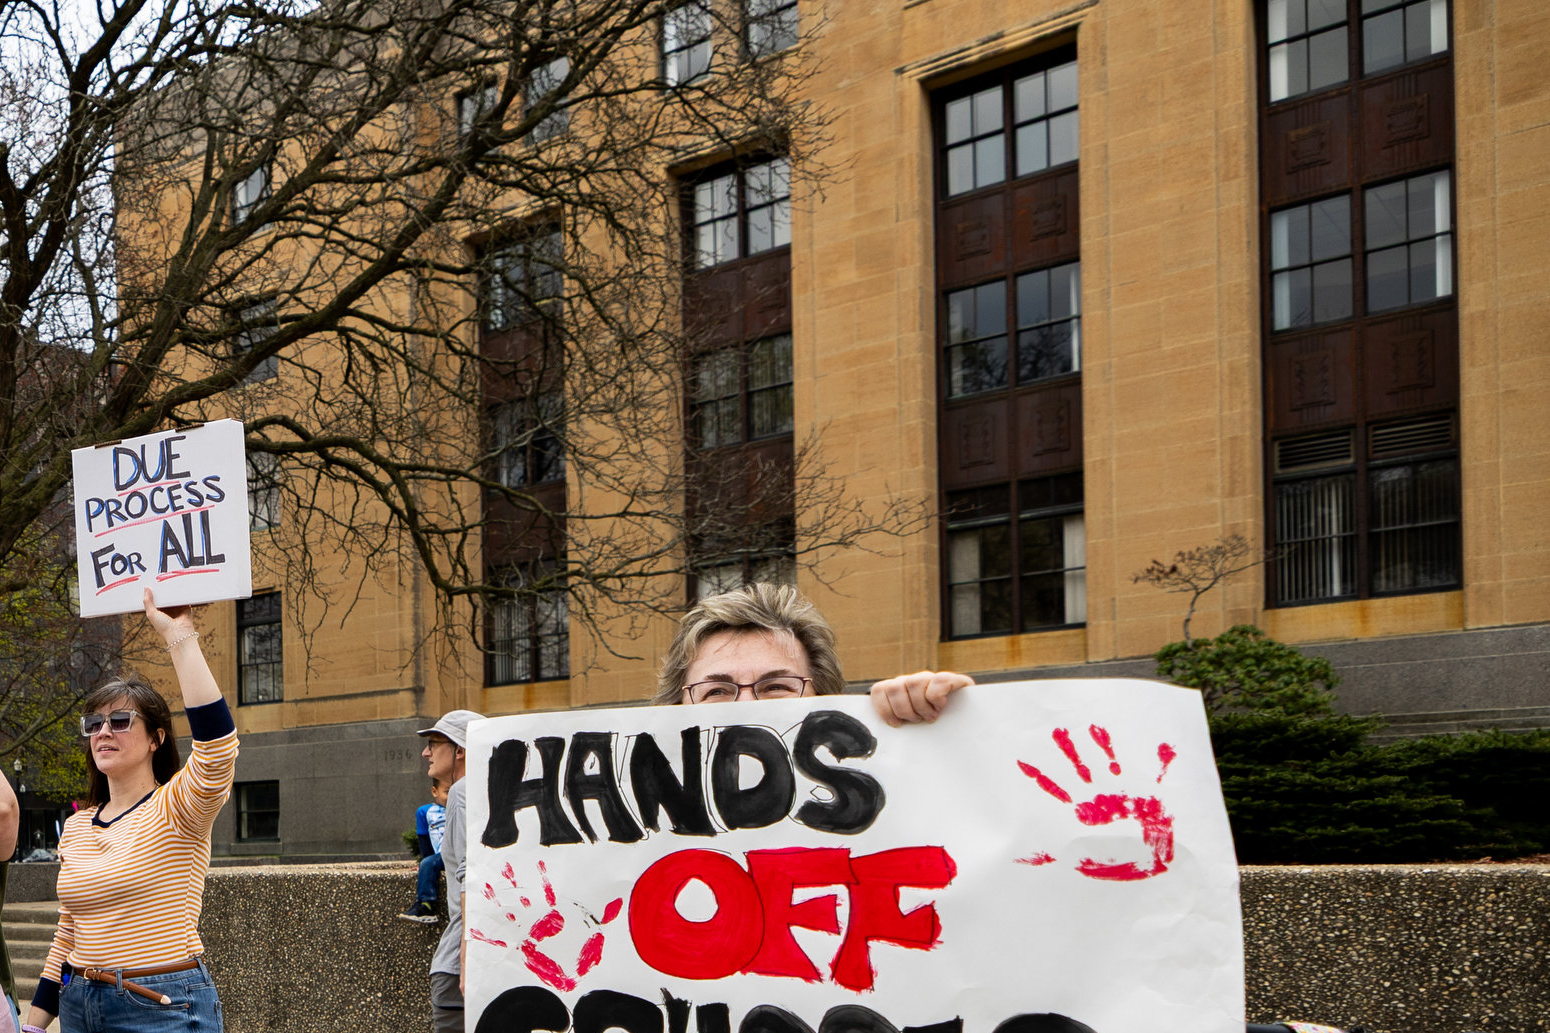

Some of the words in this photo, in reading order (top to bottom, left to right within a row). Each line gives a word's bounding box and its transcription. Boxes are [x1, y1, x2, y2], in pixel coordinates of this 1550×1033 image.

[112, 435, 191, 492] DUE
[85, 475, 226, 533] PROCESS
[158, 509, 226, 574] ALL
[480, 710, 887, 849] HANDS
[627, 844, 959, 995] OFF
